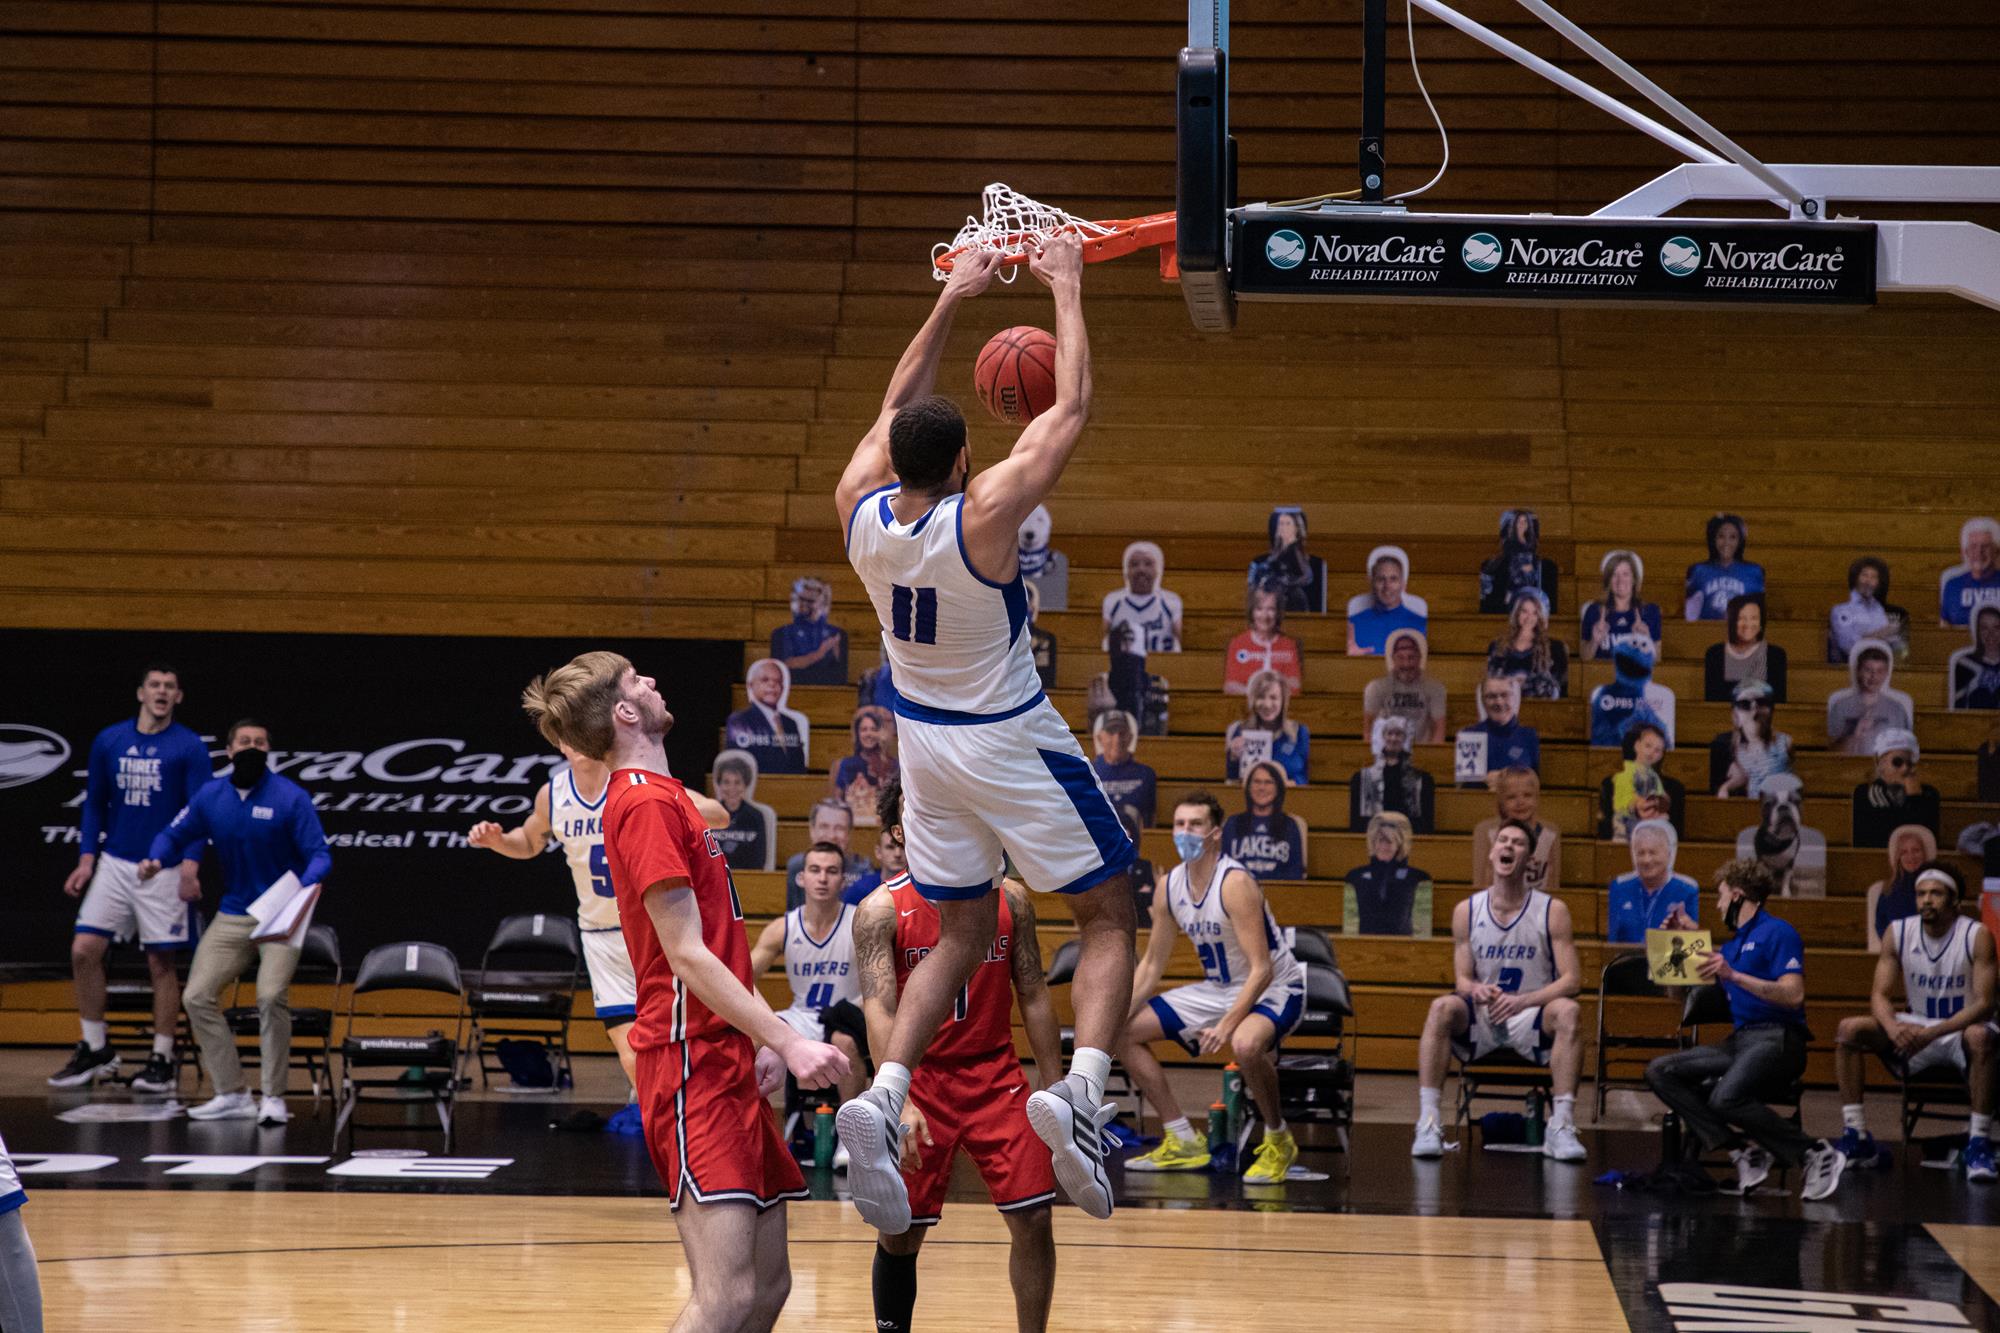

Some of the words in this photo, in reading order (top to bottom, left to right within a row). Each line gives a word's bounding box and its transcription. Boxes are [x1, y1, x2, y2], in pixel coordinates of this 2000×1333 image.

[1308, 234, 1446, 264] NovaCare
[1505, 238, 1644, 268] NovaCare
[1703, 241, 1845, 272] NovaCare
[1309, 268, 1440, 282] REHABILITATION
[1505, 271, 1637, 287] REHABILITATION
[1704, 275, 1839, 290] REHABILITATION
[891, 583, 938, 646] 11
[118, 757, 162, 776] THREE
[115, 774, 163, 791] STRIPE
[124, 790, 151, 806] LIFE
[1477, 945, 1538, 960] LAKERS
[794, 961, 850, 976] LAKERS
[806, 982, 835, 1010] 4
